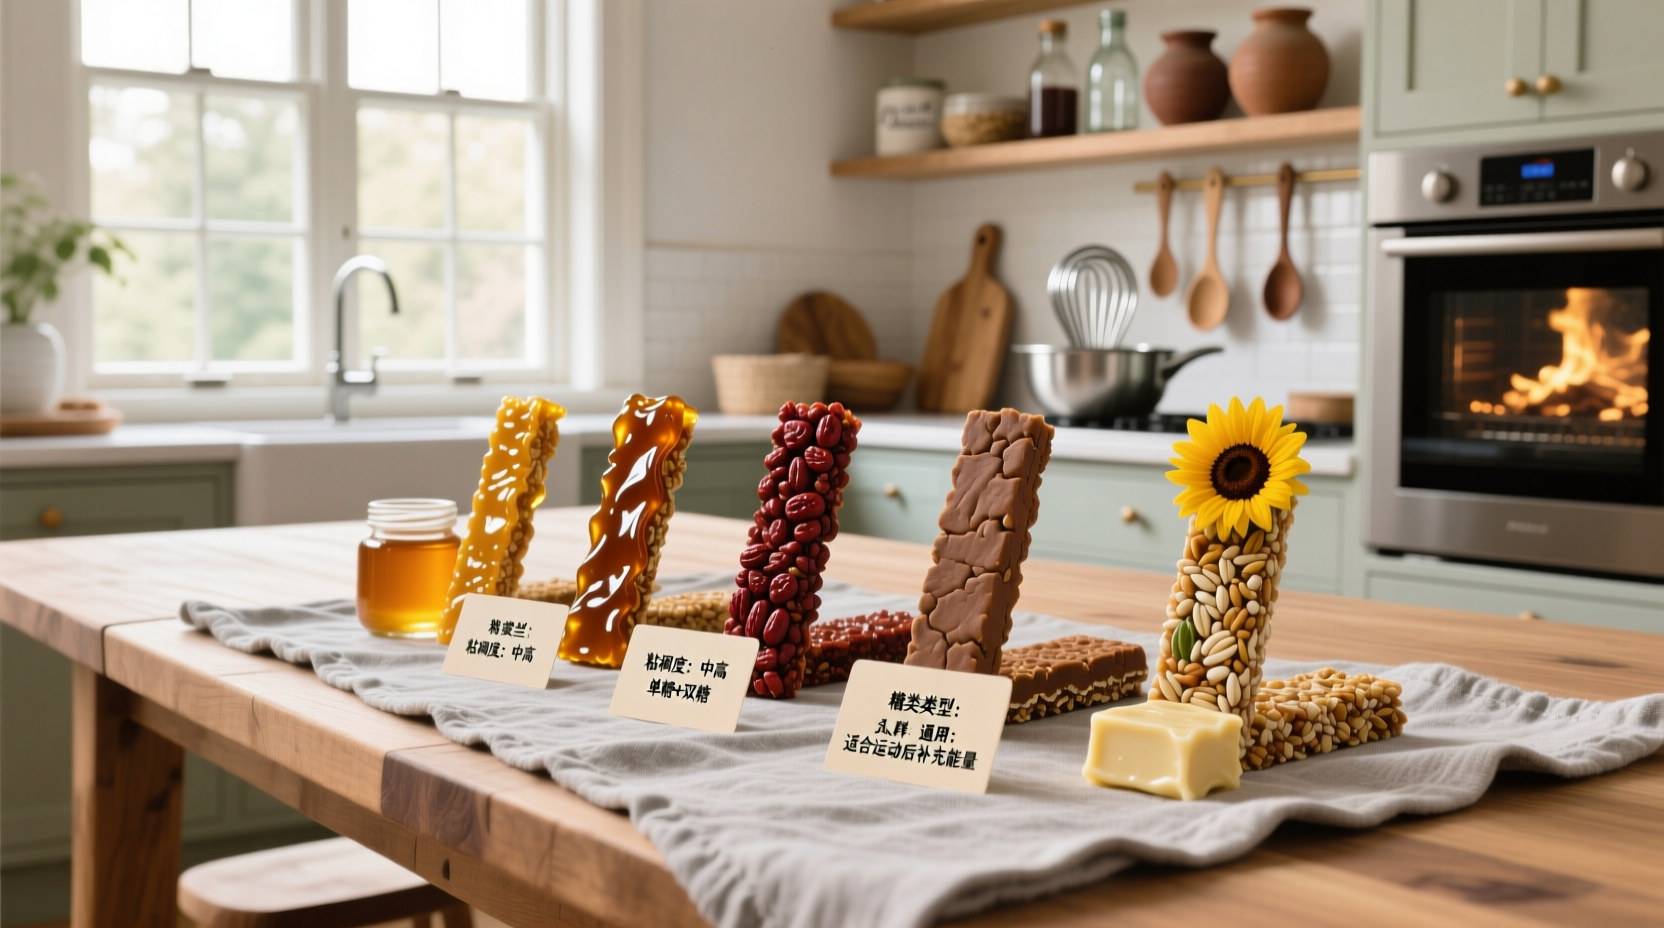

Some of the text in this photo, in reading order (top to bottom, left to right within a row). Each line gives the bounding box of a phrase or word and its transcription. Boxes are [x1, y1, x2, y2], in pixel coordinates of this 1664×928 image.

[843, 734, 977, 770] 适合运动后补充能量
